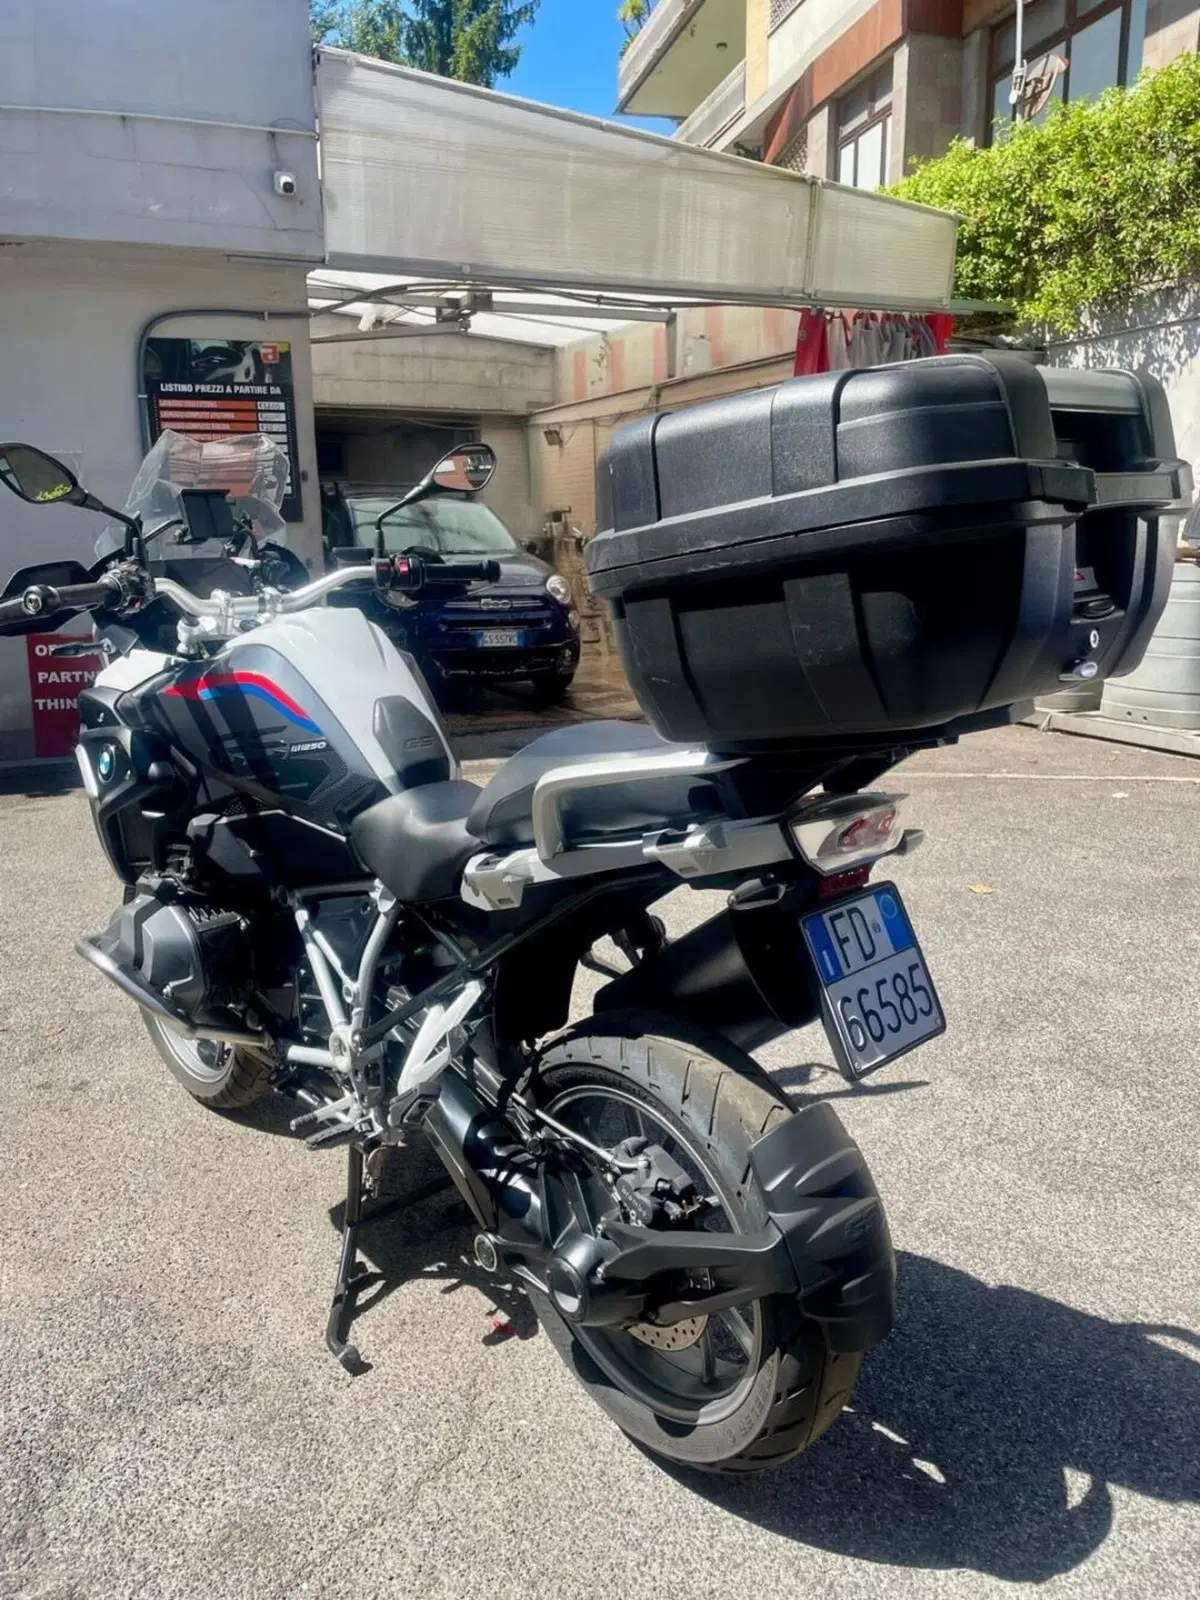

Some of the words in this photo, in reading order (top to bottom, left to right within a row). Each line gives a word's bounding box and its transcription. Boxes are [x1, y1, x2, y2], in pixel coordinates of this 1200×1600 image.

[160, 383, 193, 393] LISTINO
[195, 384, 224, 394] PREZZI
[226, 385, 233, 394] A
[234, 385, 268, 395] PARTIRE
[270, 386, 281, 395] DA
[480, 598, 511, 610] 500
[37, 671, 100, 684] PARTN
[828, 906, 876, 969] FD
[837, 962, 934, 1053] 66585
